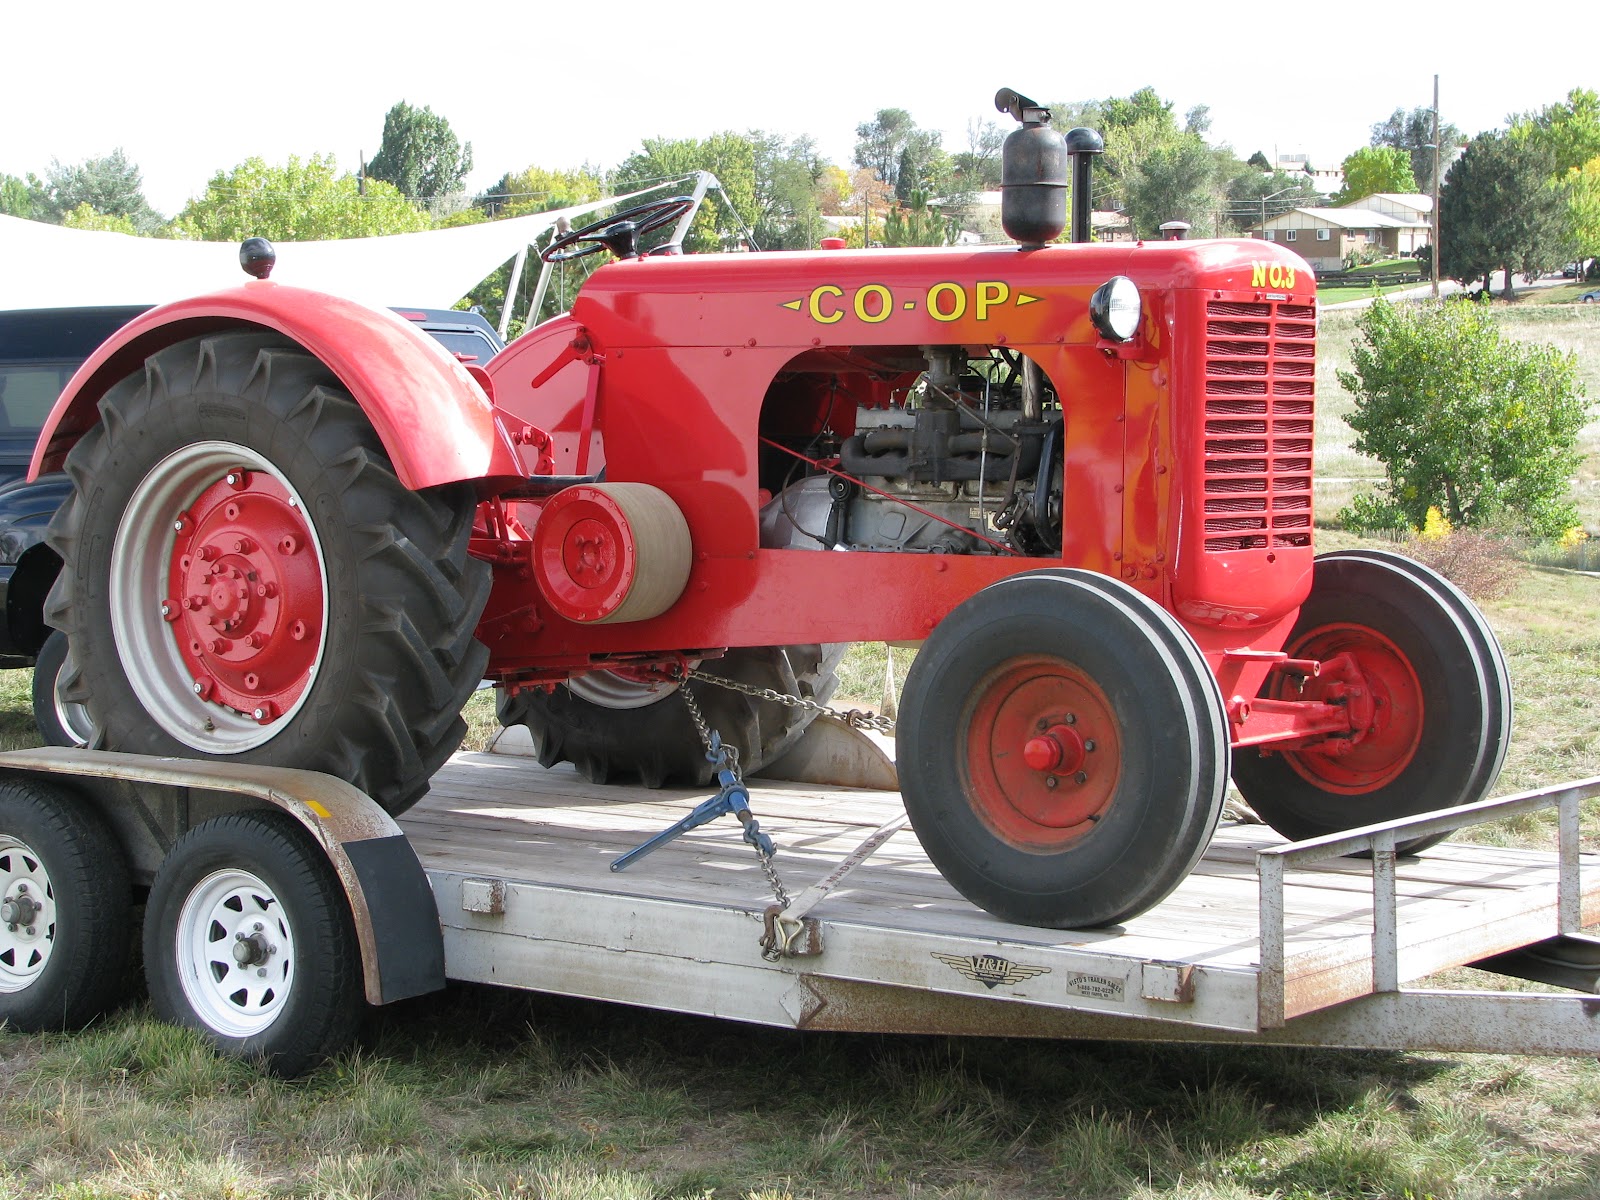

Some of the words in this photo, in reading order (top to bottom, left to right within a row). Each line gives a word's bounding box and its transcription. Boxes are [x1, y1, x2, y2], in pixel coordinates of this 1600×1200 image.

[1251, 260, 1295, 289] NO.3
[808, 280, 1010, 324] CO-OP
[826, 861, 856, 882] MADE
[853, 851, 868, 859] IN
[975, 957, 1008, 973] H&H
[1088, 976, 1107, 985] TRAILER
[1107, 981, 1122, 993] SALES
